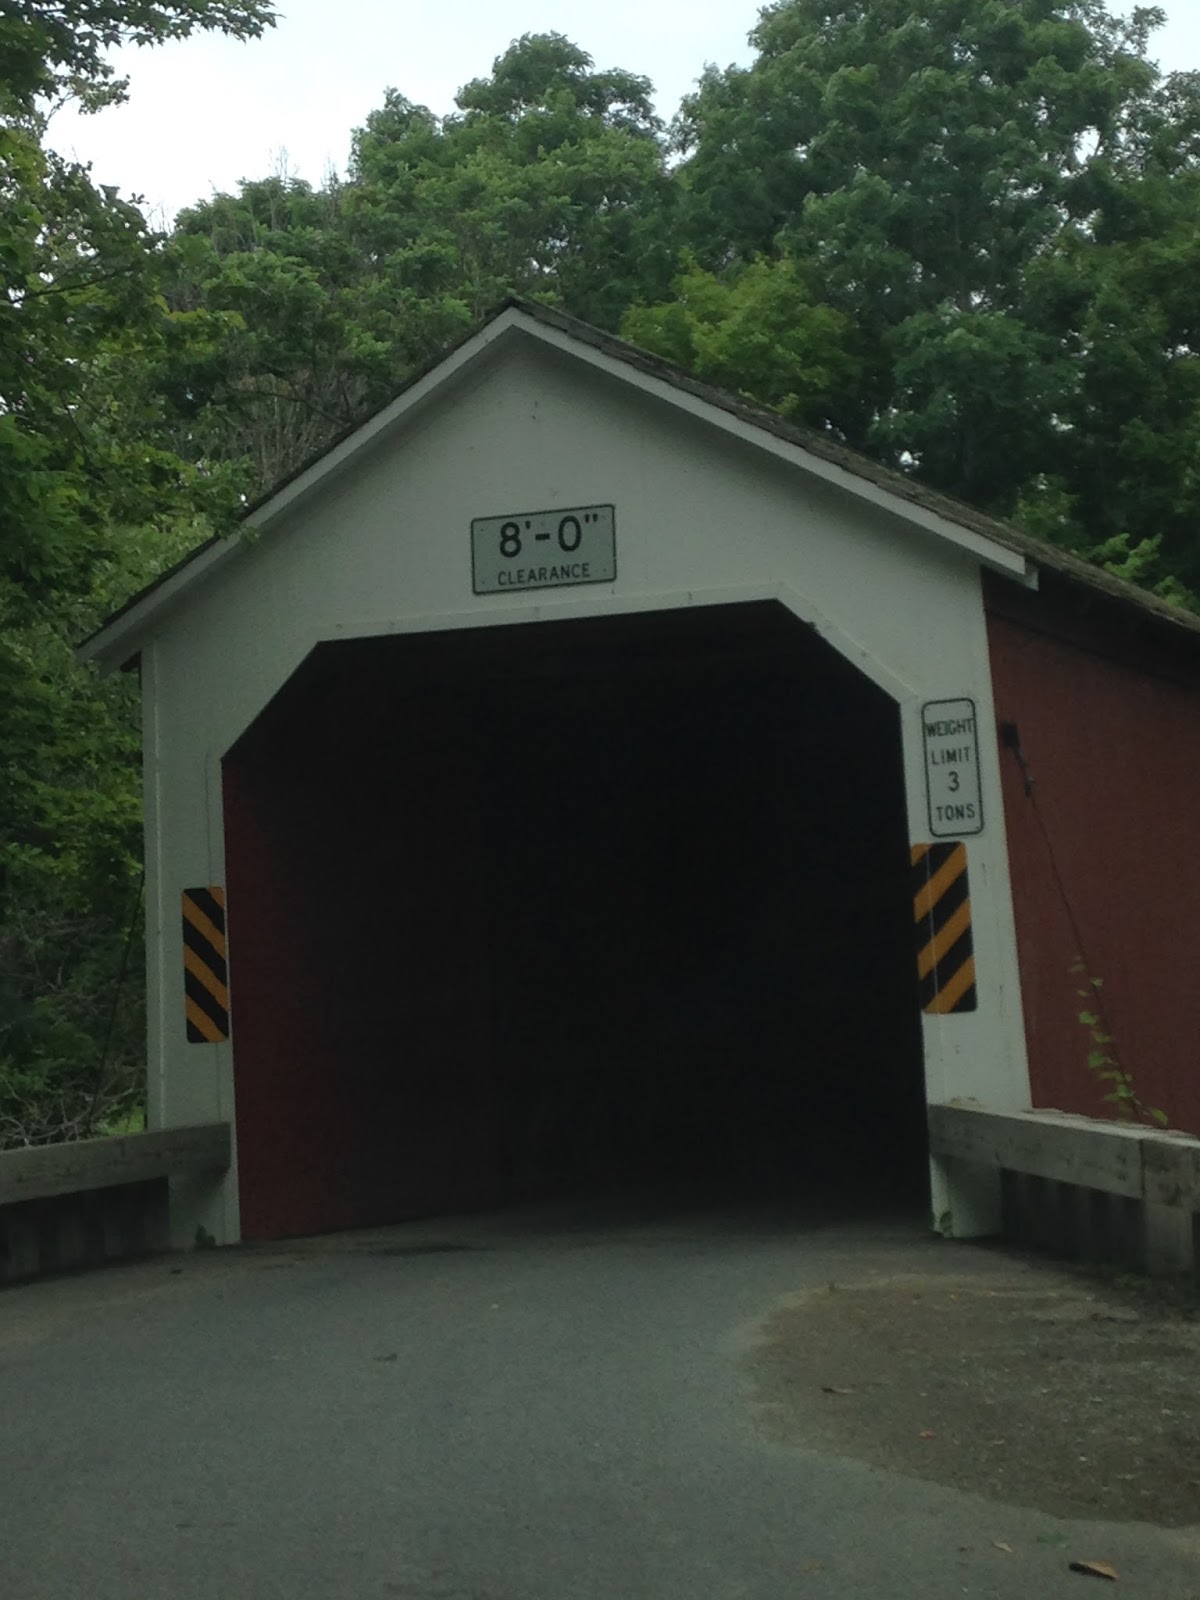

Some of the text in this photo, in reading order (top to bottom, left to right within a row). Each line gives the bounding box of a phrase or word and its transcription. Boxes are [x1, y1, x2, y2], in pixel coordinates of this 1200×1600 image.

[498, 563, 591, 586] CLEARANCE
[926, 718, 974, 737] WEIGHT
[931, 747, 970, 765] LIMIT
[948, 771, 960, 792] 3
[936, 803, 976, 821] TONS
